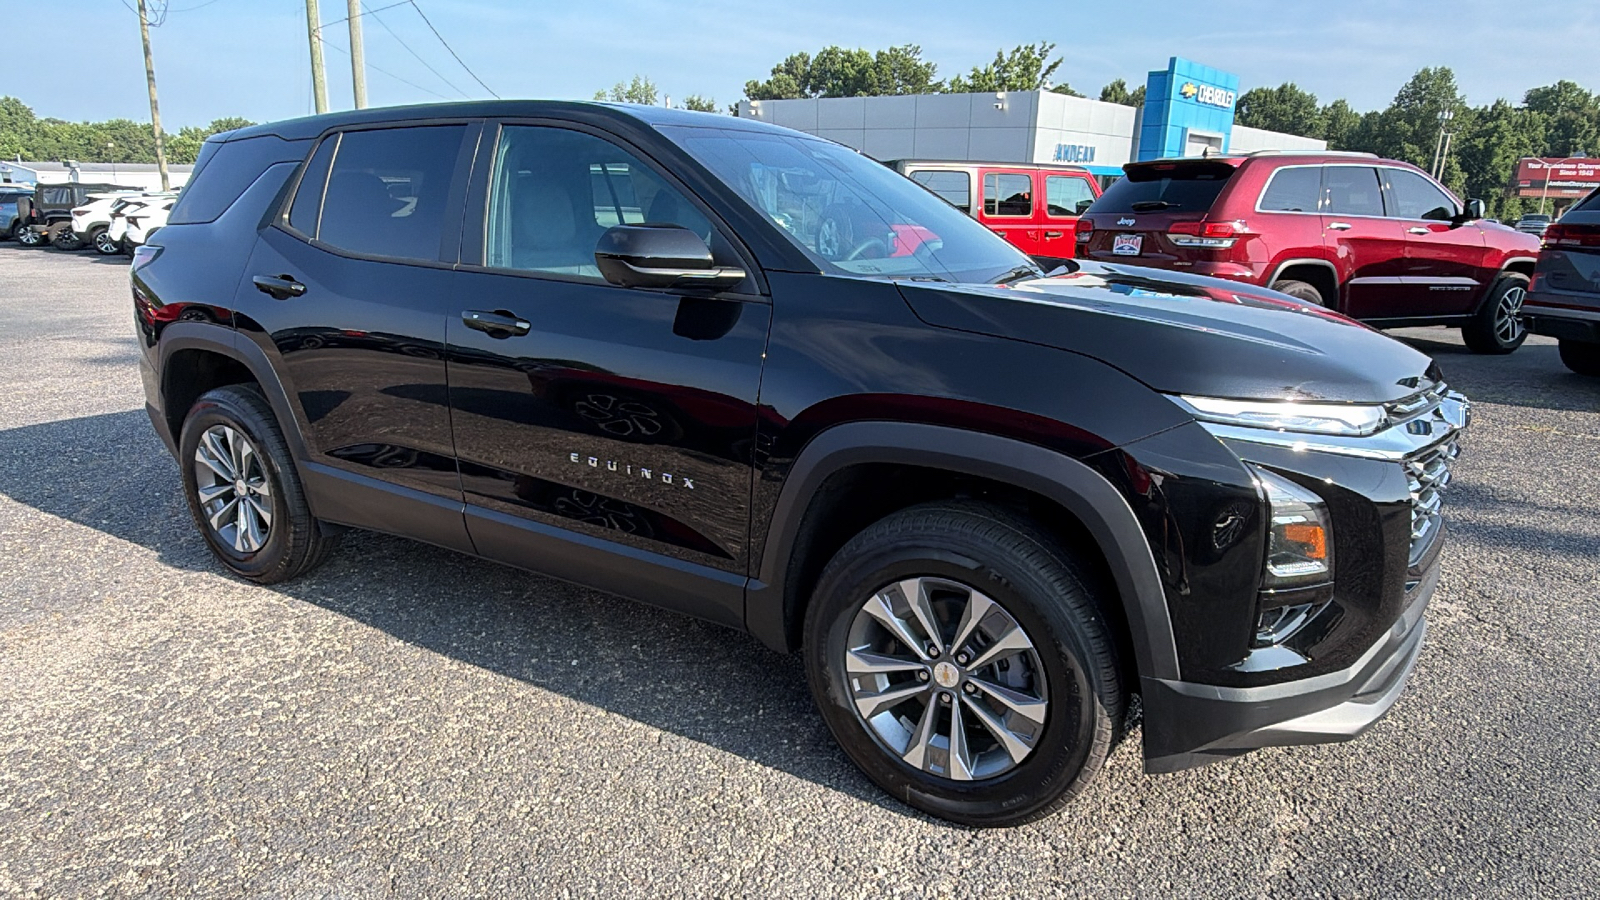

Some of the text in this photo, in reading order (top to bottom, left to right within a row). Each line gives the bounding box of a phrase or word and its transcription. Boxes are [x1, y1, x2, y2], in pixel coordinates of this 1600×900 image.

[1198, 84, 1234, 107] CHEVROLET
[1053, 143, 1095, 163] ANDEAN
[1117, 216, 1136, 227] Jeep
[570, 452, 694, 489] EQUINOX
